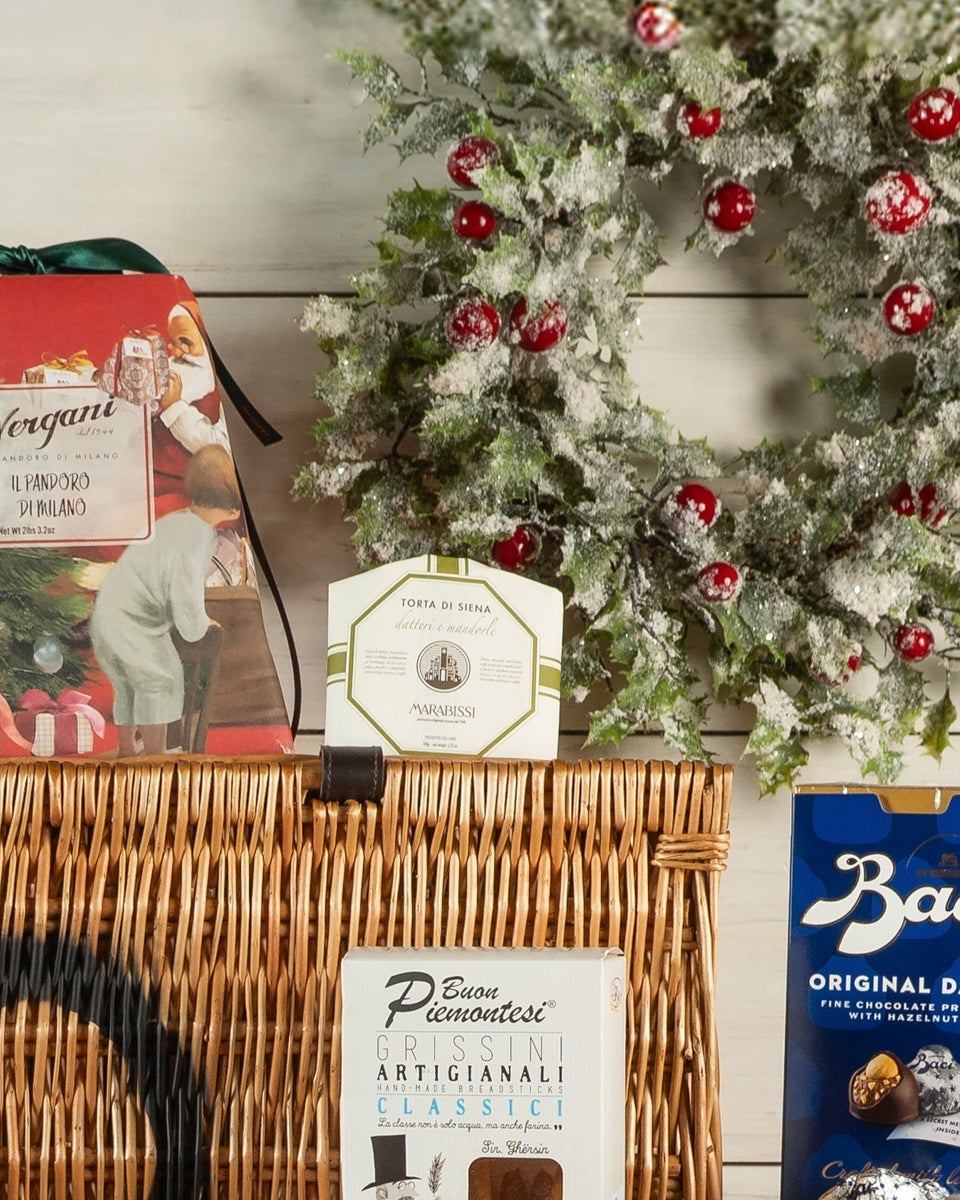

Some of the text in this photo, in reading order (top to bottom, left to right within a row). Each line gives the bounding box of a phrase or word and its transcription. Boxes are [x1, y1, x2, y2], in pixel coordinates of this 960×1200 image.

[92, 427, 114, 436] 1944
[57, 453, 67, 461] DI
[75, 452, 119, 460] MILANO
[12, 472, 90, 492] IL PANDORO
[17, 498, 87, 518] DI MILANO
[12, 526, 21, 535] Wt
[22, 526, 36, 535] 2lbs
[38, 526, 55, 535] 3.2oz
[401, 598, 491, 614] TORTA DI SIENA
[395, 609, 434, 631] datteri
[447, 616, 499, 637] mandorle
[409, 703, 476, 718] MARABISSI
[808, 973, 960, 995] ORIGINAL D
[385, 971, 547, 1029] Buon Piemontesi
[820, 999, 851, 1009] FINE
[856, 1000, 935, 1012] CHOCOLATE
[848, 1012, 959, 1023] WITH HAZELNUT
[376, 1035, 563, 1062] GRISSINI
[907, 1053, 954, 1075] Baci
[376, 1064, 563, 1083] ARTIGIANALI
[377, 1084, 563, 1095] HAND-MADE BREADSTICKS
[377, 1097, 563, 1117] CLASSICI
[378, 1117, 391, 1128] La
[392, 1119, 417, 1128] classe
[433, 1119, 438, 1128] è
[440, 1120, 456, 1129] solo
[500, 1121, 523, 1130] anche
[936, 1127, 959, 1136] INSIDE
[505, 1140, 550, 1156] Ghërsin
